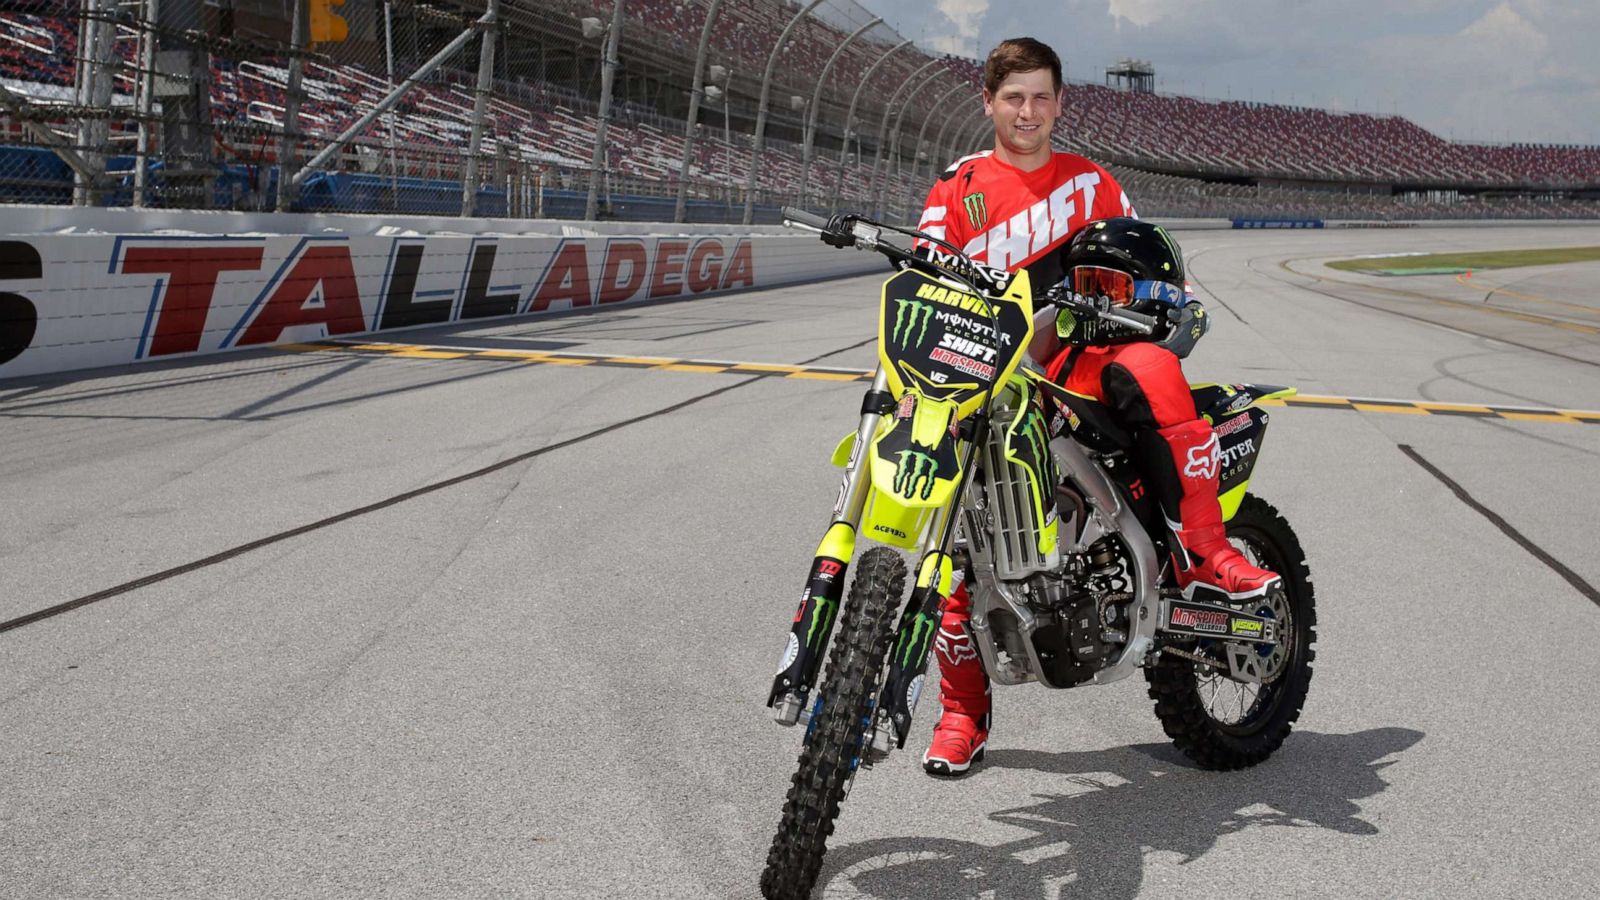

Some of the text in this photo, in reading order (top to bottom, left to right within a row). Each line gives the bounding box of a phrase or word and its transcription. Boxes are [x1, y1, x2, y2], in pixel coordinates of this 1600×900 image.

[110, 236, 755, 358] TALLADEGA
[935, 311, 1012, 346] MONSTER
[945, 325, 997, 347] ENERGY
[1220, 438, 1255, 468] STER
[1222, 462, 1250, 480] ERGY
[1231, 618, 1263, 633] VISION
